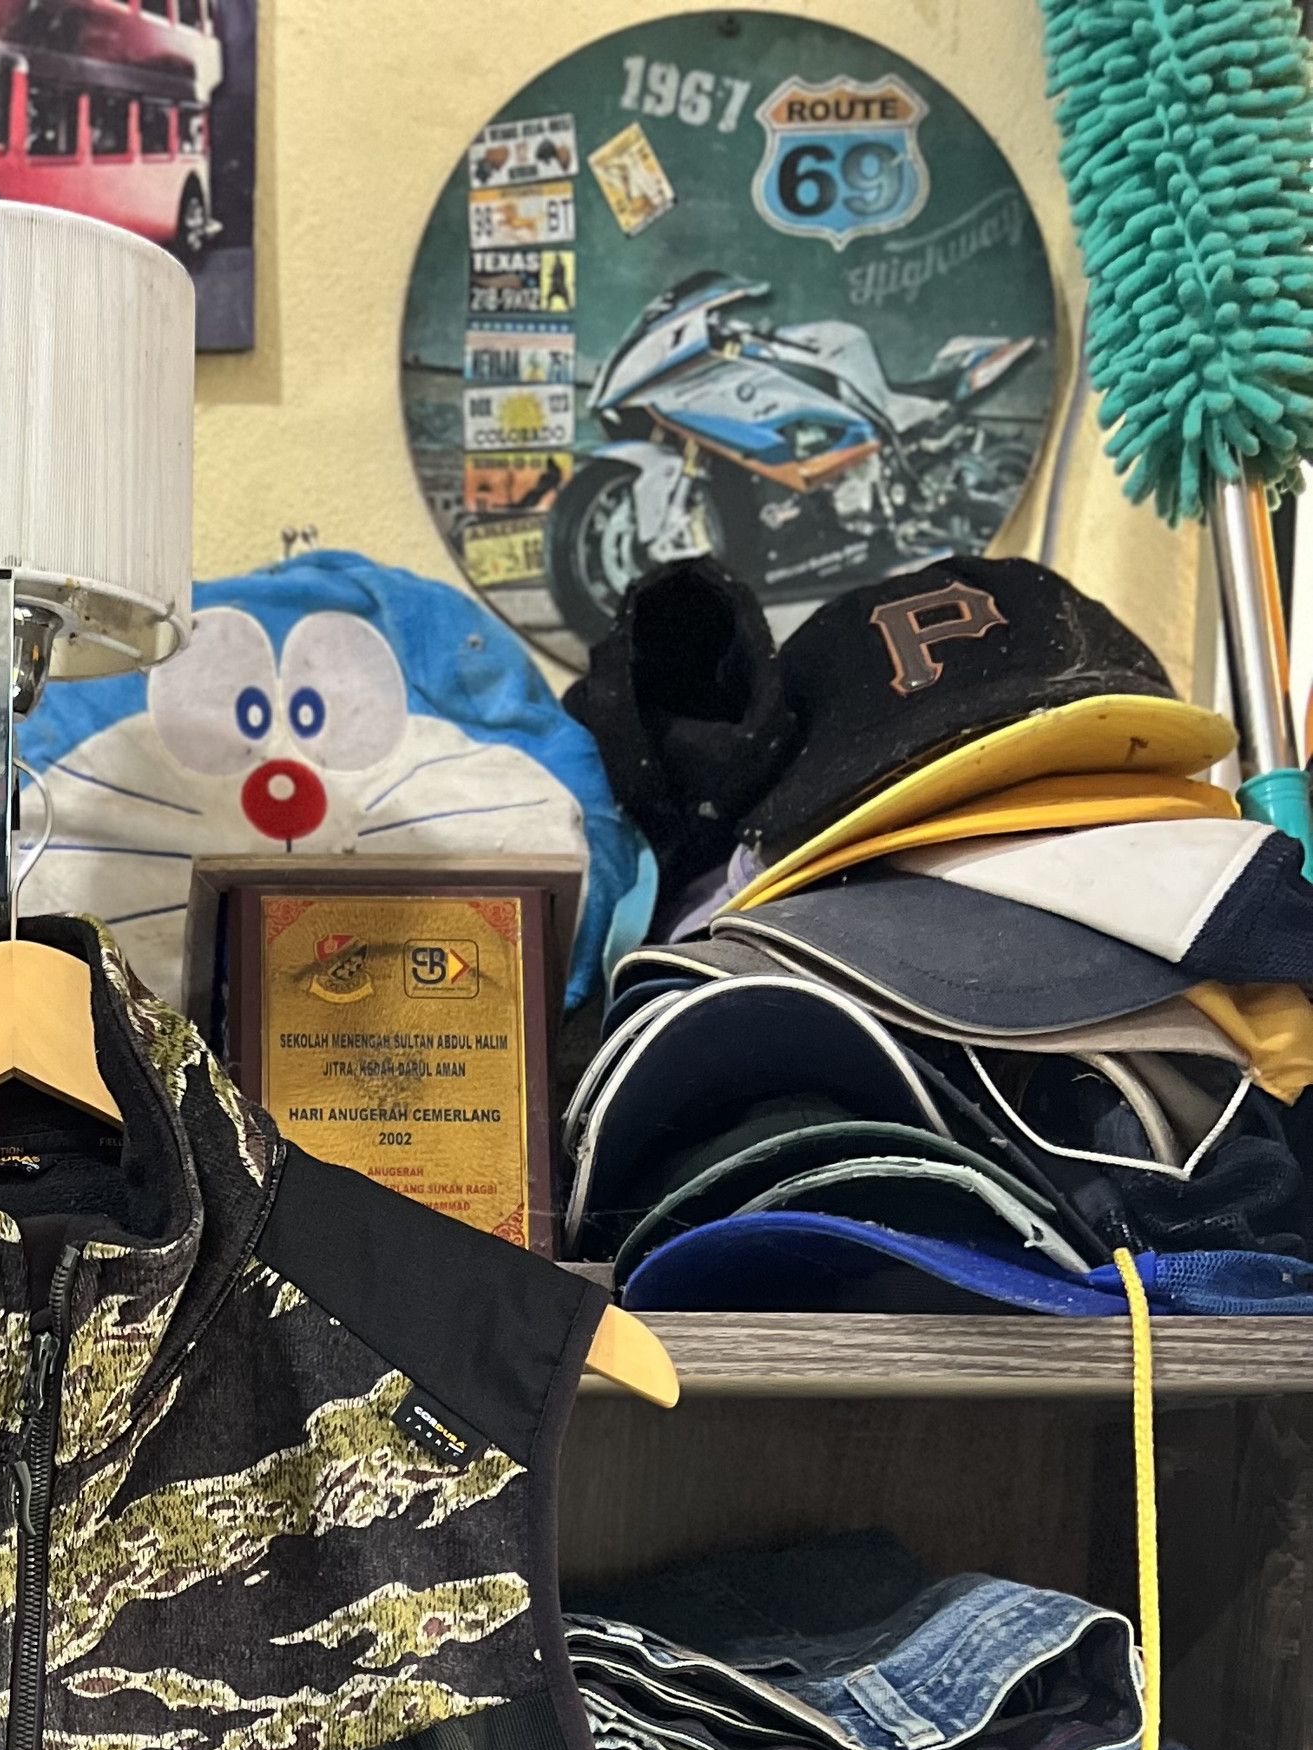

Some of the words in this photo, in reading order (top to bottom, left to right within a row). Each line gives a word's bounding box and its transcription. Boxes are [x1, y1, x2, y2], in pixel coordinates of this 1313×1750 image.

[620, 54, 751, 133] 1967
[788, 98, 899, 123] ROUTE
[778, 142, 904, 217] 69
[846, 199, 1024, 306] Highway
[472, 252, 540, 273] TEXAS
[474, 426, 565, 445] COLORADO
[870, 582, 1008, 697] P
[280, 1033, 328, 1048] SEKOLAH
[331, 1034, 389, 1049] MENENGAH
[394, 1034, 434, 1049] SULTAN
[437, 1035, 472, 1049] ABDUL
[475, 1035, 508, 1049] HALIM
[359, 1062, 394, 1077] KEDAH
[397, 1062, 432, 1077] DARUL
[435, 1062, 466, 1077] AMAN
[289, 1108, 323, 1121] HARI
[328, 1108, 408, 1122] ANUGERAH
[412, 1108, 501, 1122] CEMERLANG
[378, 1132, 413, 1146] 2002
[368, 1167, 424, 1177] ANUGERAH
[427, 1184, 462, 1194] SUKAN
[466, 1184, 497, 1195] RAGBI
